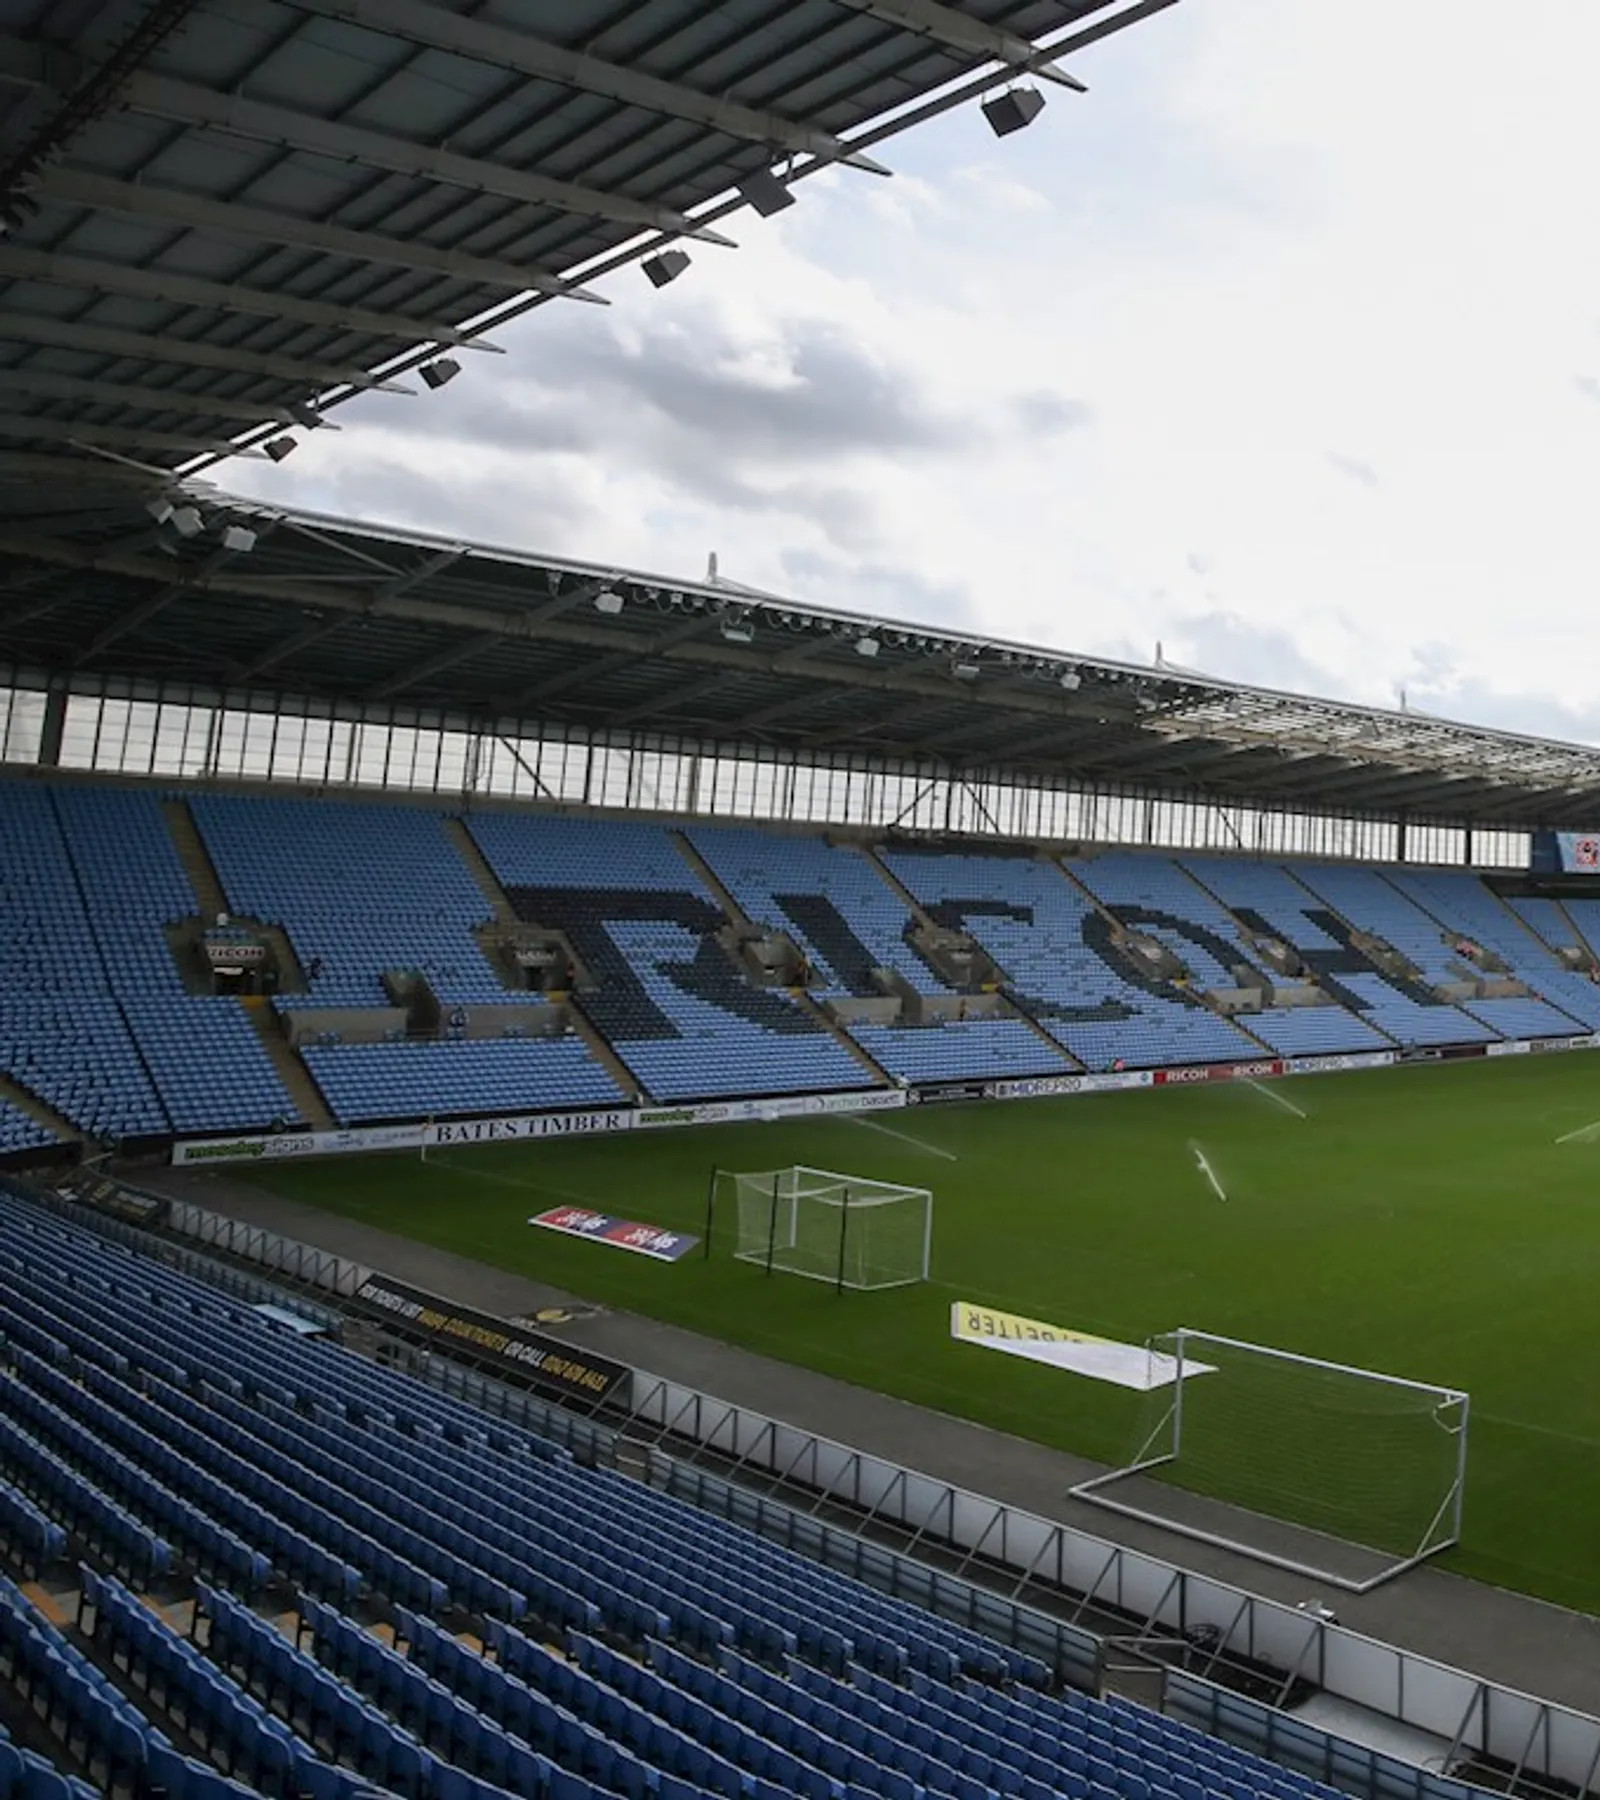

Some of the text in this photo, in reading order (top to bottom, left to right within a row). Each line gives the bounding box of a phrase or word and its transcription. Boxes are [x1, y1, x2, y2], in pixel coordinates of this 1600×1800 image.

[504, 884, 1452, 1039] RICOH
[1167, 1069, 1209, 1082] RICOH
[1232, 1063, 1273, 1076] RICOH
[1011, 1079, 1082, 1095] MIDREPRO
[436, 1119, 517, 1143] BATES
[525, 1113, 620, 1135] TIMBER
[517, 1345, 547, 1368] CALL
